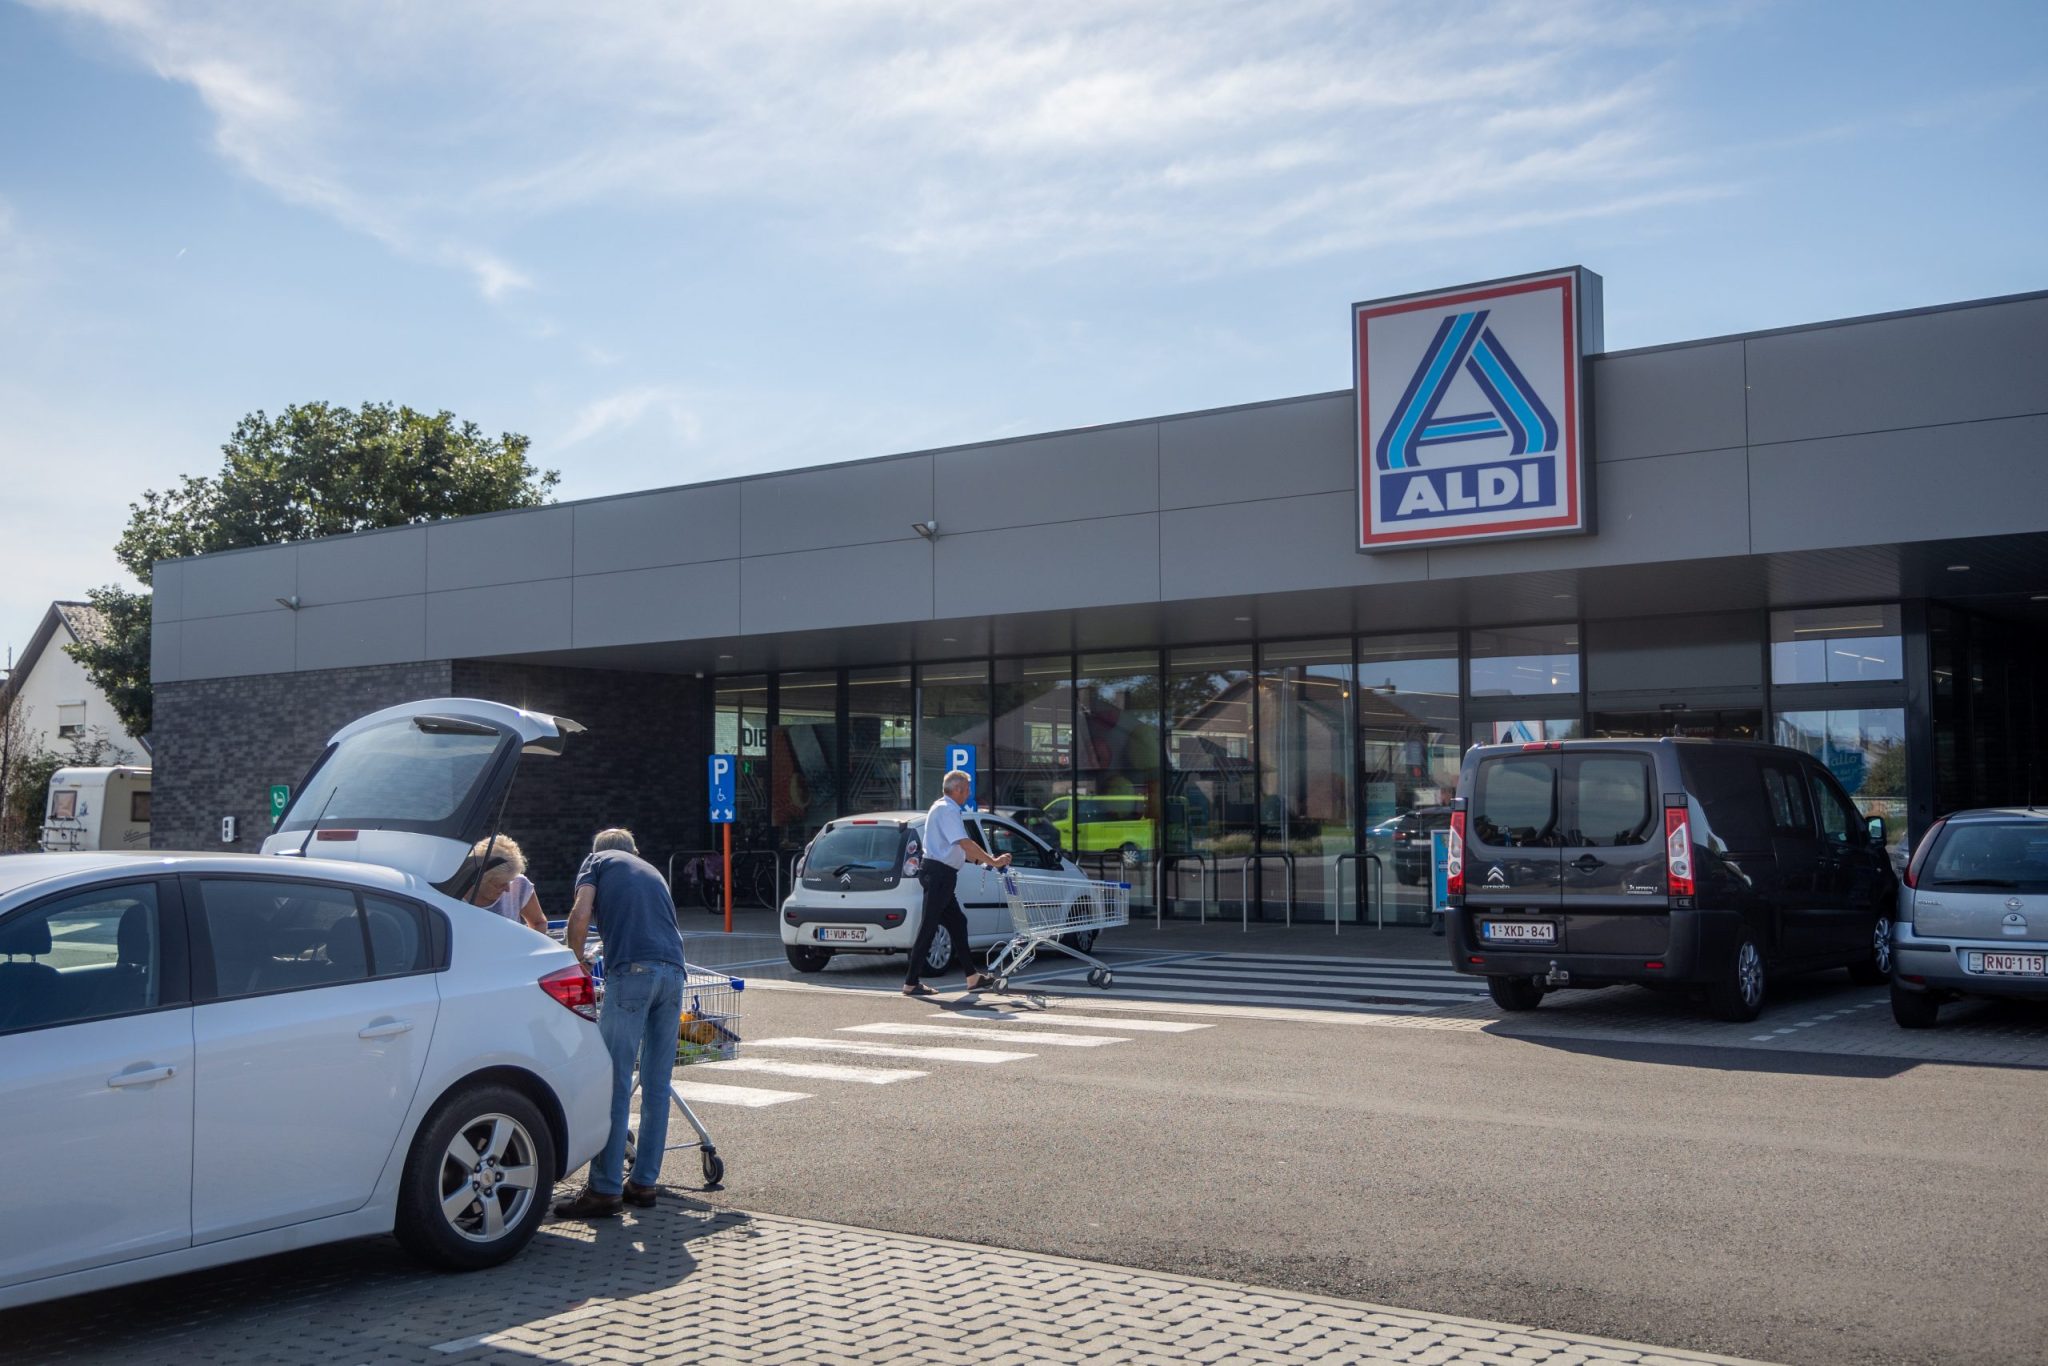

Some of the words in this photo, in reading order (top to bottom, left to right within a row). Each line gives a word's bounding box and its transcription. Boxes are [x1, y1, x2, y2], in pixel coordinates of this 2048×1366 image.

[1395, 463, 1540, 516] ALDI
[714, 758, 729, 785] P
[953, 749, 969, 771] P
